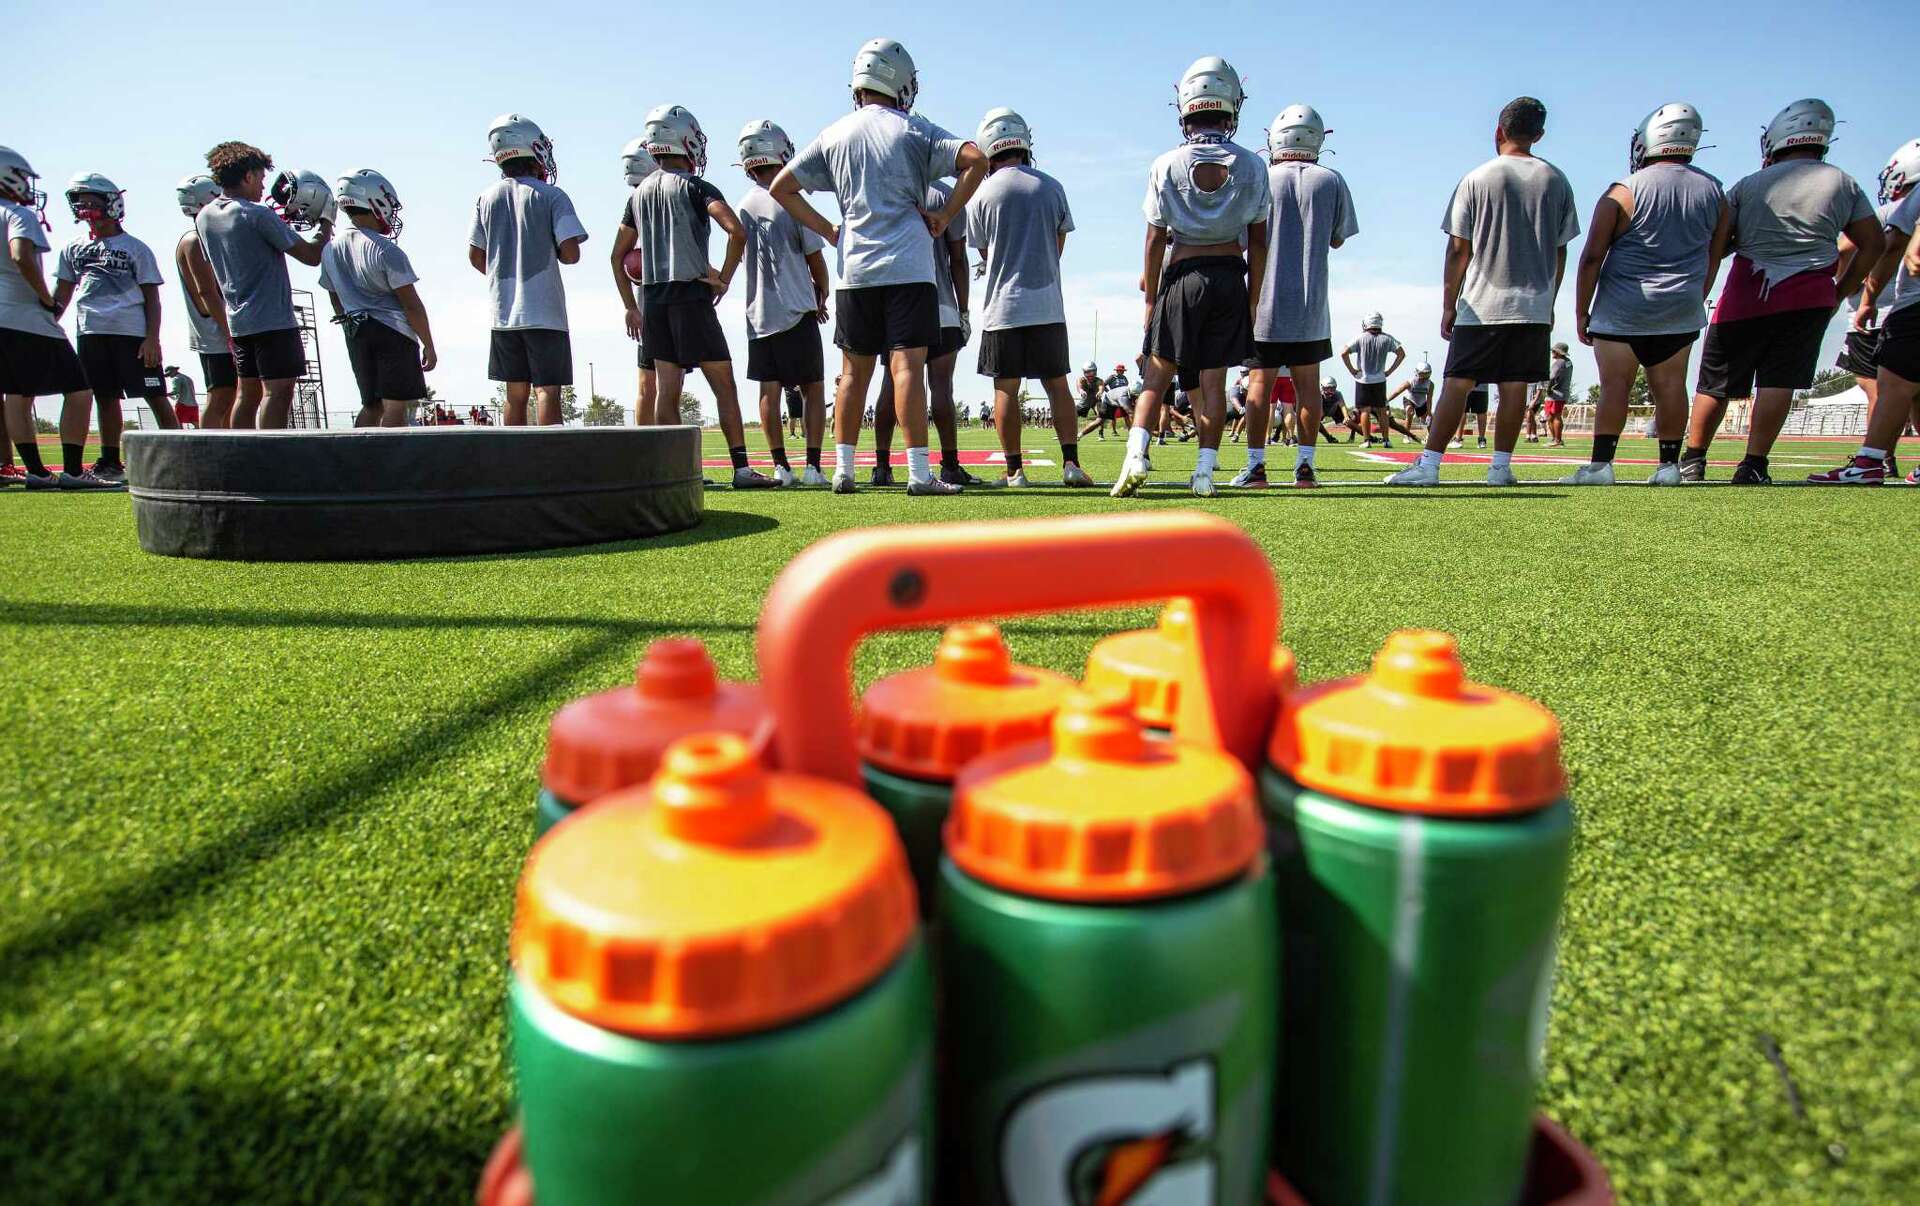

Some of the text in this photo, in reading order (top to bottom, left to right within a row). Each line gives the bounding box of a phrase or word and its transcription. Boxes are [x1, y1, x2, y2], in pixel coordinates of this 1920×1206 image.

[1188, 101, 1222, 112] Riddell
[994, 139, 1021, 151] Riddell
[1786, 136, 1823, 145] Riddell
